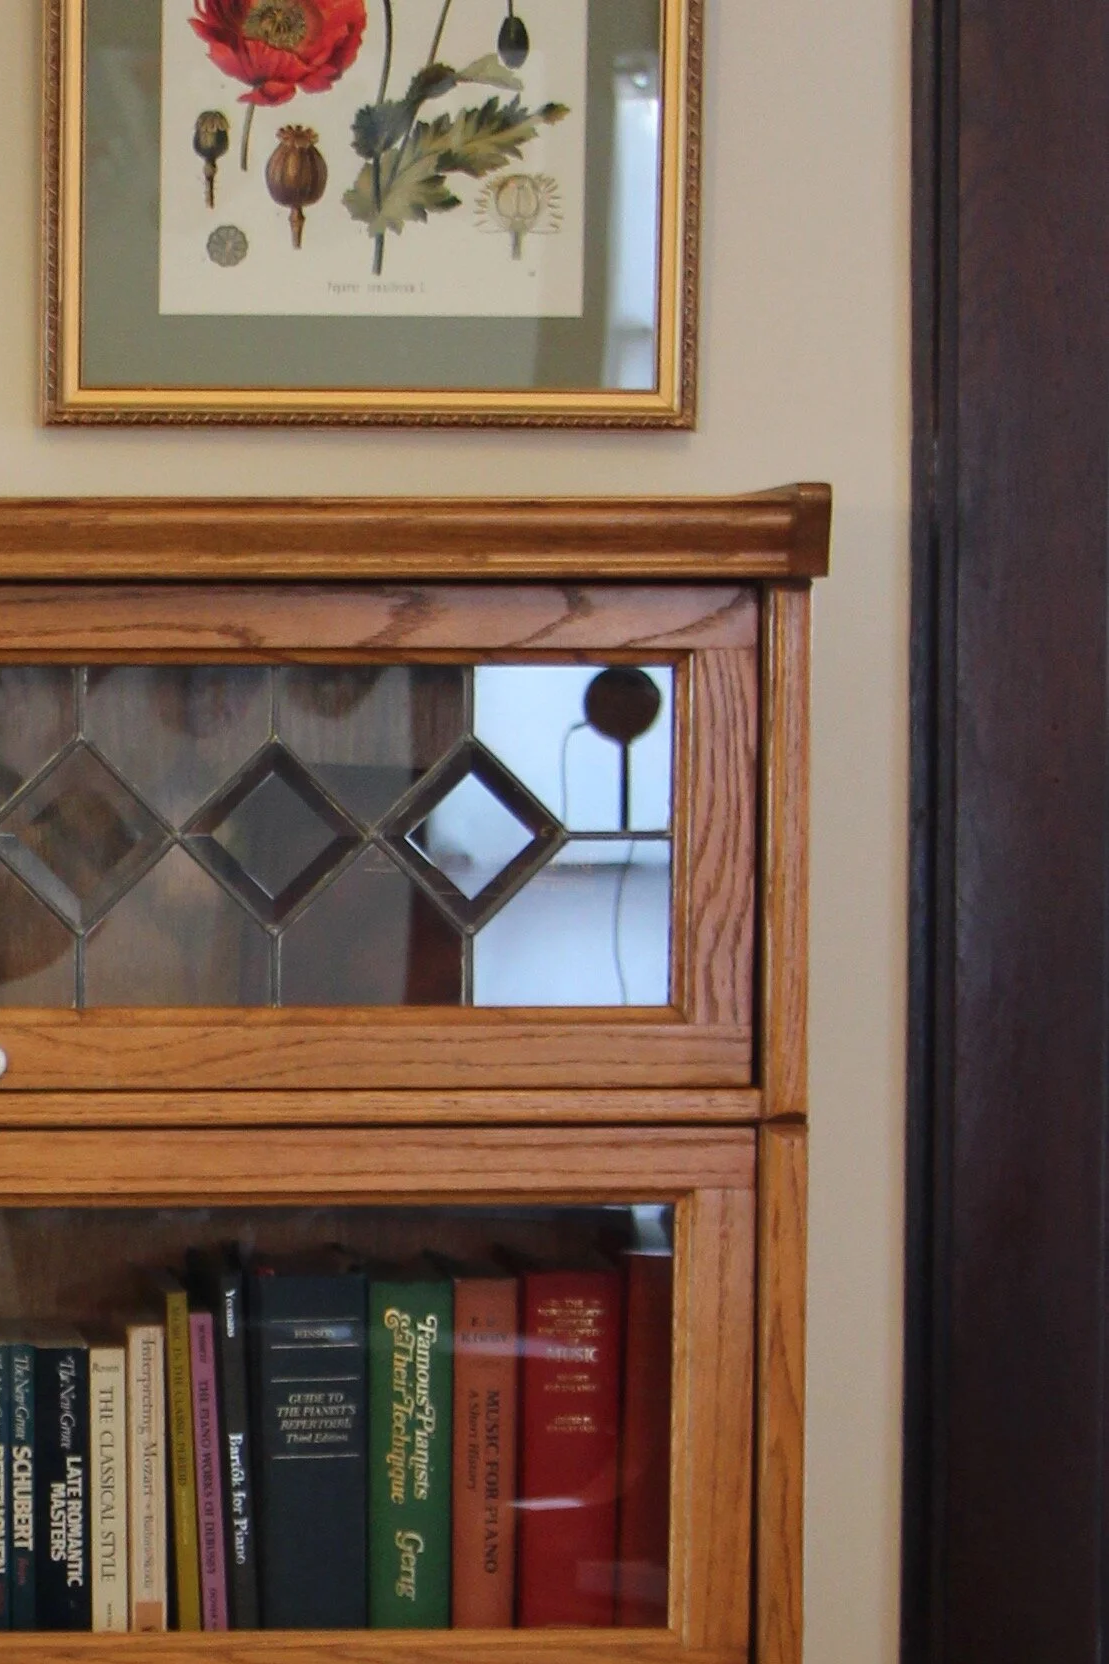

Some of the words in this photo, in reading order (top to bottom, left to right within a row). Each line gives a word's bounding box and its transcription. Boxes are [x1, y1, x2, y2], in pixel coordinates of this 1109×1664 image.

[225, 1289, 237, 1338] Yeomans
[14, 1355, 29, 1378] The
[58, 1358, 76, 1381] The
[414, 1314, 437, 1407] Famous
[546, 1346, 599, 1362] MUSIC
[99, 1386, 114, 1423] THE
[137, 1339, 155, 1435] Interpreting
[197, 1380, 213, 1404] THE
[289, 1394, 325, 1404] GUIDE
[328, 1393, 344, 1402] TO
[199, 1409, 213, 1448] PIANO
[277, 1407, 300, 1417] THE
[303, 1405, 356, 1417] PIANIST'S
[280, 1419, 352, 1431] REPERTOIRE
[468, 1403, 481, 1438] Short
[485, 1389, 500, 1455] MUSIC
[227, 1433, 244, 1487] Bartók
[287, 1433, 312, 1443] Third
[314, 1432, 348, 1443] Edition
[386, 1397, 413, 1504] Technique
[409, 1407, 436, 1499] Pianists
[66, 1456, 82, 1495] LATE
[100, 1430, 116, 1524] CLASSICAL
[143, 1443, 158, 1496] Mozart
[176, 1443, 188, 1486] PERIOD
[201, 1452, 214, 1496] WORKS
[466, 1444, 480, 1492] History
[484, 1461, 500, 1500] FOR
[12, 1446, 33, 1550] SCHUBERT
[203, 1501, 215, 1518] OF
[231, 1491, 246, 1513] for
[50, 1483, 66, 1561] MASTERS
[67, 1500, 82, 1586] ROMANTIC
[233, 1519, 248, 1565] Piano
[484, 1506, 499, 1574] PIANO
[101, 1531, 117, 1582] STYLE
[204, 1522, 218, 1575] DEBUSSY
[396, 1530, 425, 1601] Gerig
